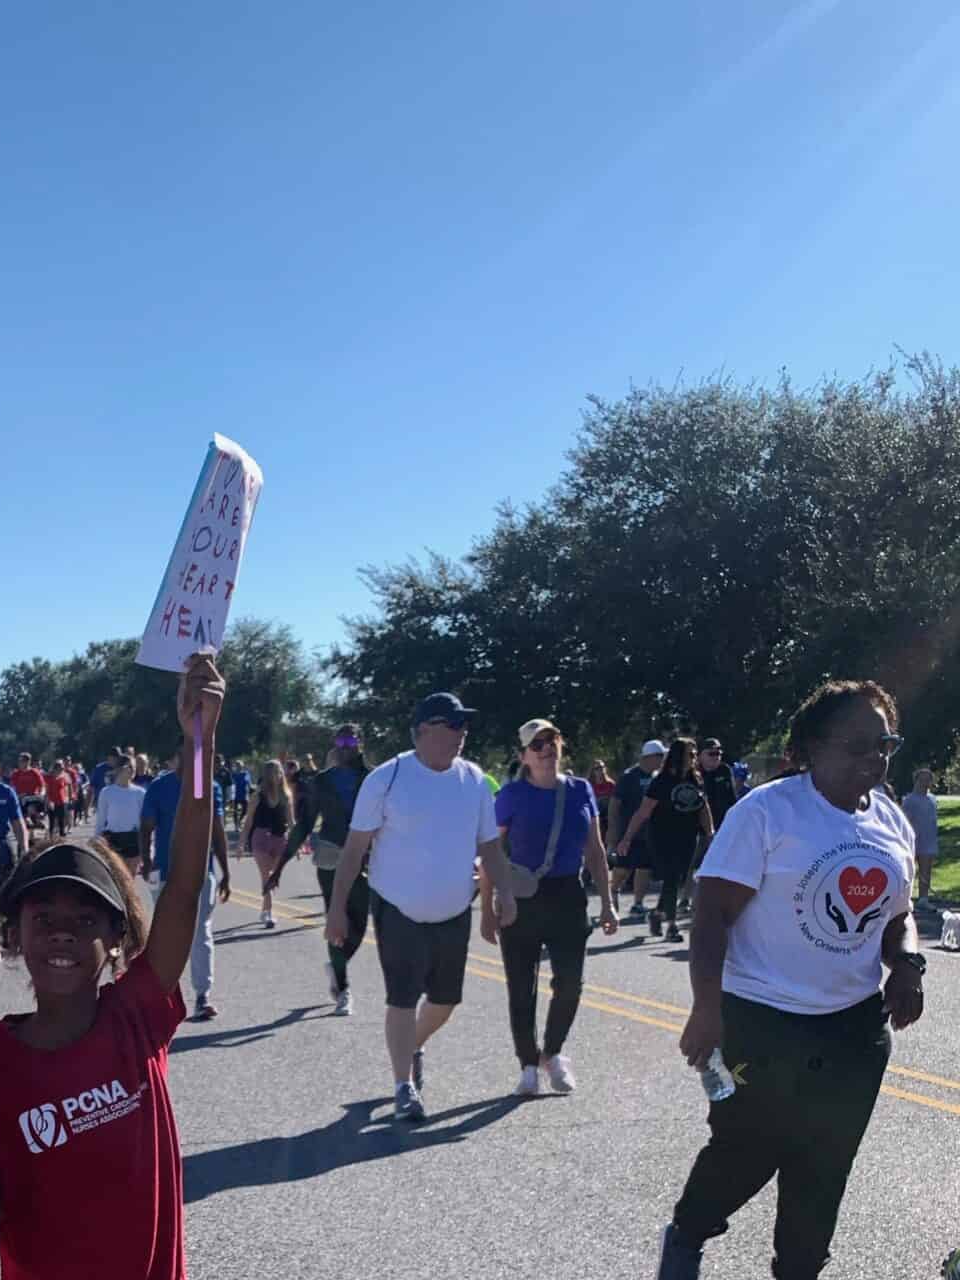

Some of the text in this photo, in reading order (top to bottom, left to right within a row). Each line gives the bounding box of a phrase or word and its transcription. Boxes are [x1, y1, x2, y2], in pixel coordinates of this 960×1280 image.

[200, 493, 240, 527] ARE
[192, 526, 240, 561] OUR
[847, 886, 875, 896] 2024
[800, 922, 816, 942] New
[815, 938, 852, 954] Orleans
[62, 1079, 129, 1120] PCNA
